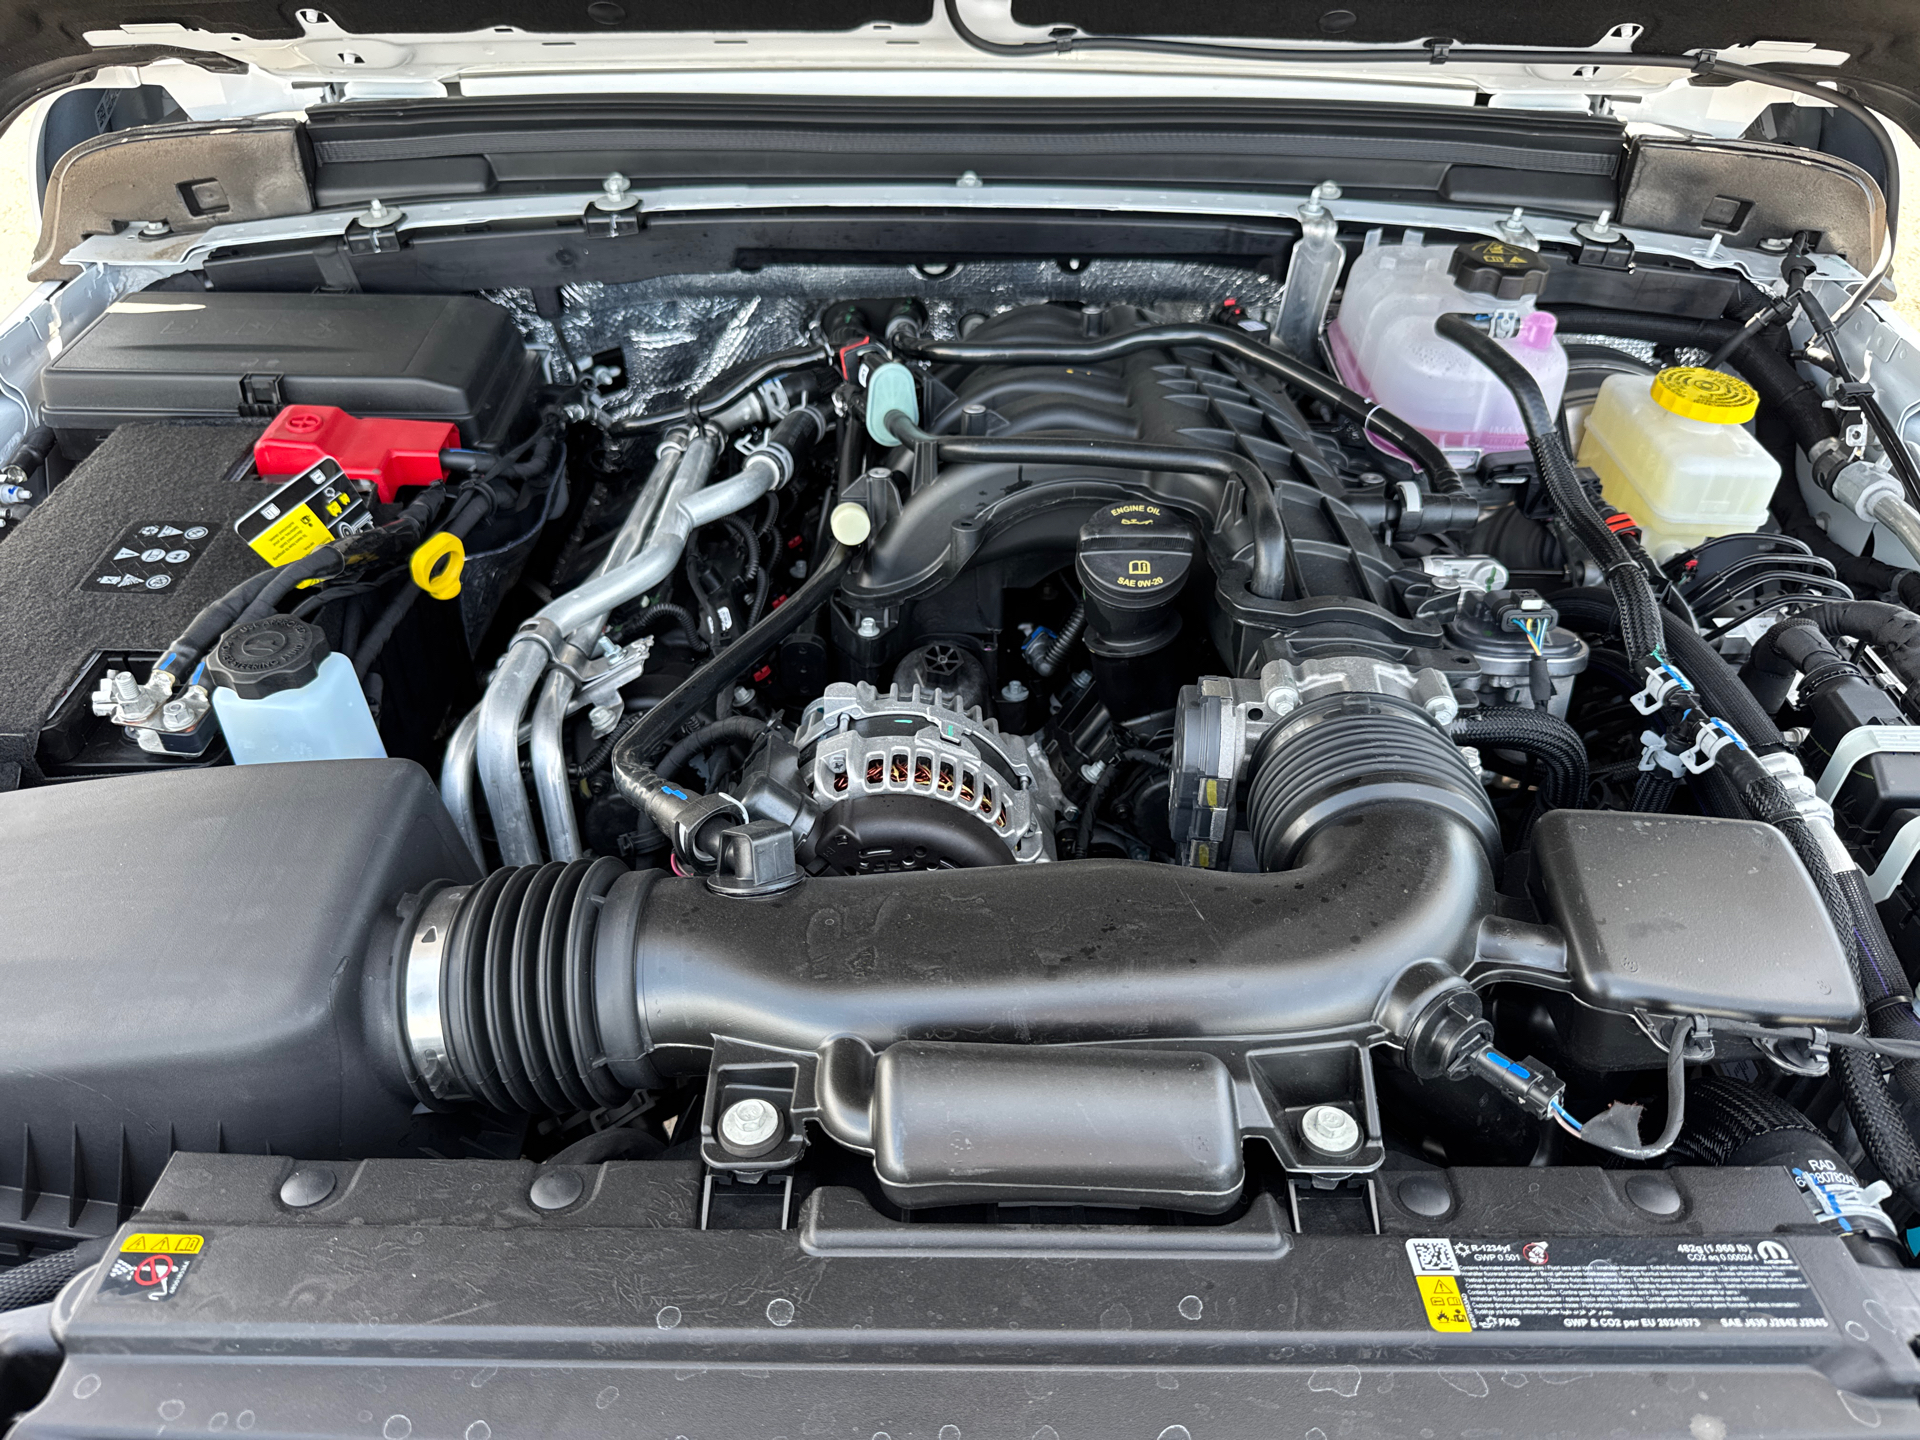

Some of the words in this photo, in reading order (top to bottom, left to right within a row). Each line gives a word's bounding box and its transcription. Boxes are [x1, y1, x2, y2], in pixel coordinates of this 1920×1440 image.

[1111, 505, 1145, 516] ENGINE
[1146, 506, 1161, 516] OIL
[1117, 576, 1136, 587] SAE
[1137, 577, 1163, 587] 0W-20
[1808, 1160, 1836, 1171] RAD
[1795, 1171, 1859, 1188] 680782AD
[1471, 1244, 1511, 1253] R-1234yf
[1677, 1244, 1703, 1254] 482g
[1736, 1244, 1752, 1254] lb)
[1497, 1253, 1521, 1261] 0.501
[1687, 1253, 1706, 1261] CO2
[1498, 1318, 1520, 1327] PAG
[1563, 1318, 1588, 1328] GWP
[1590, 1318, 1598, 1328] &
[1600, 1318, 1621, 1328] CO2
[1623, 1320, 1640, 1330] per
[1641, 1318, 1656, 1328] EU
[1720, 1317, 1743, 1328] SAE
